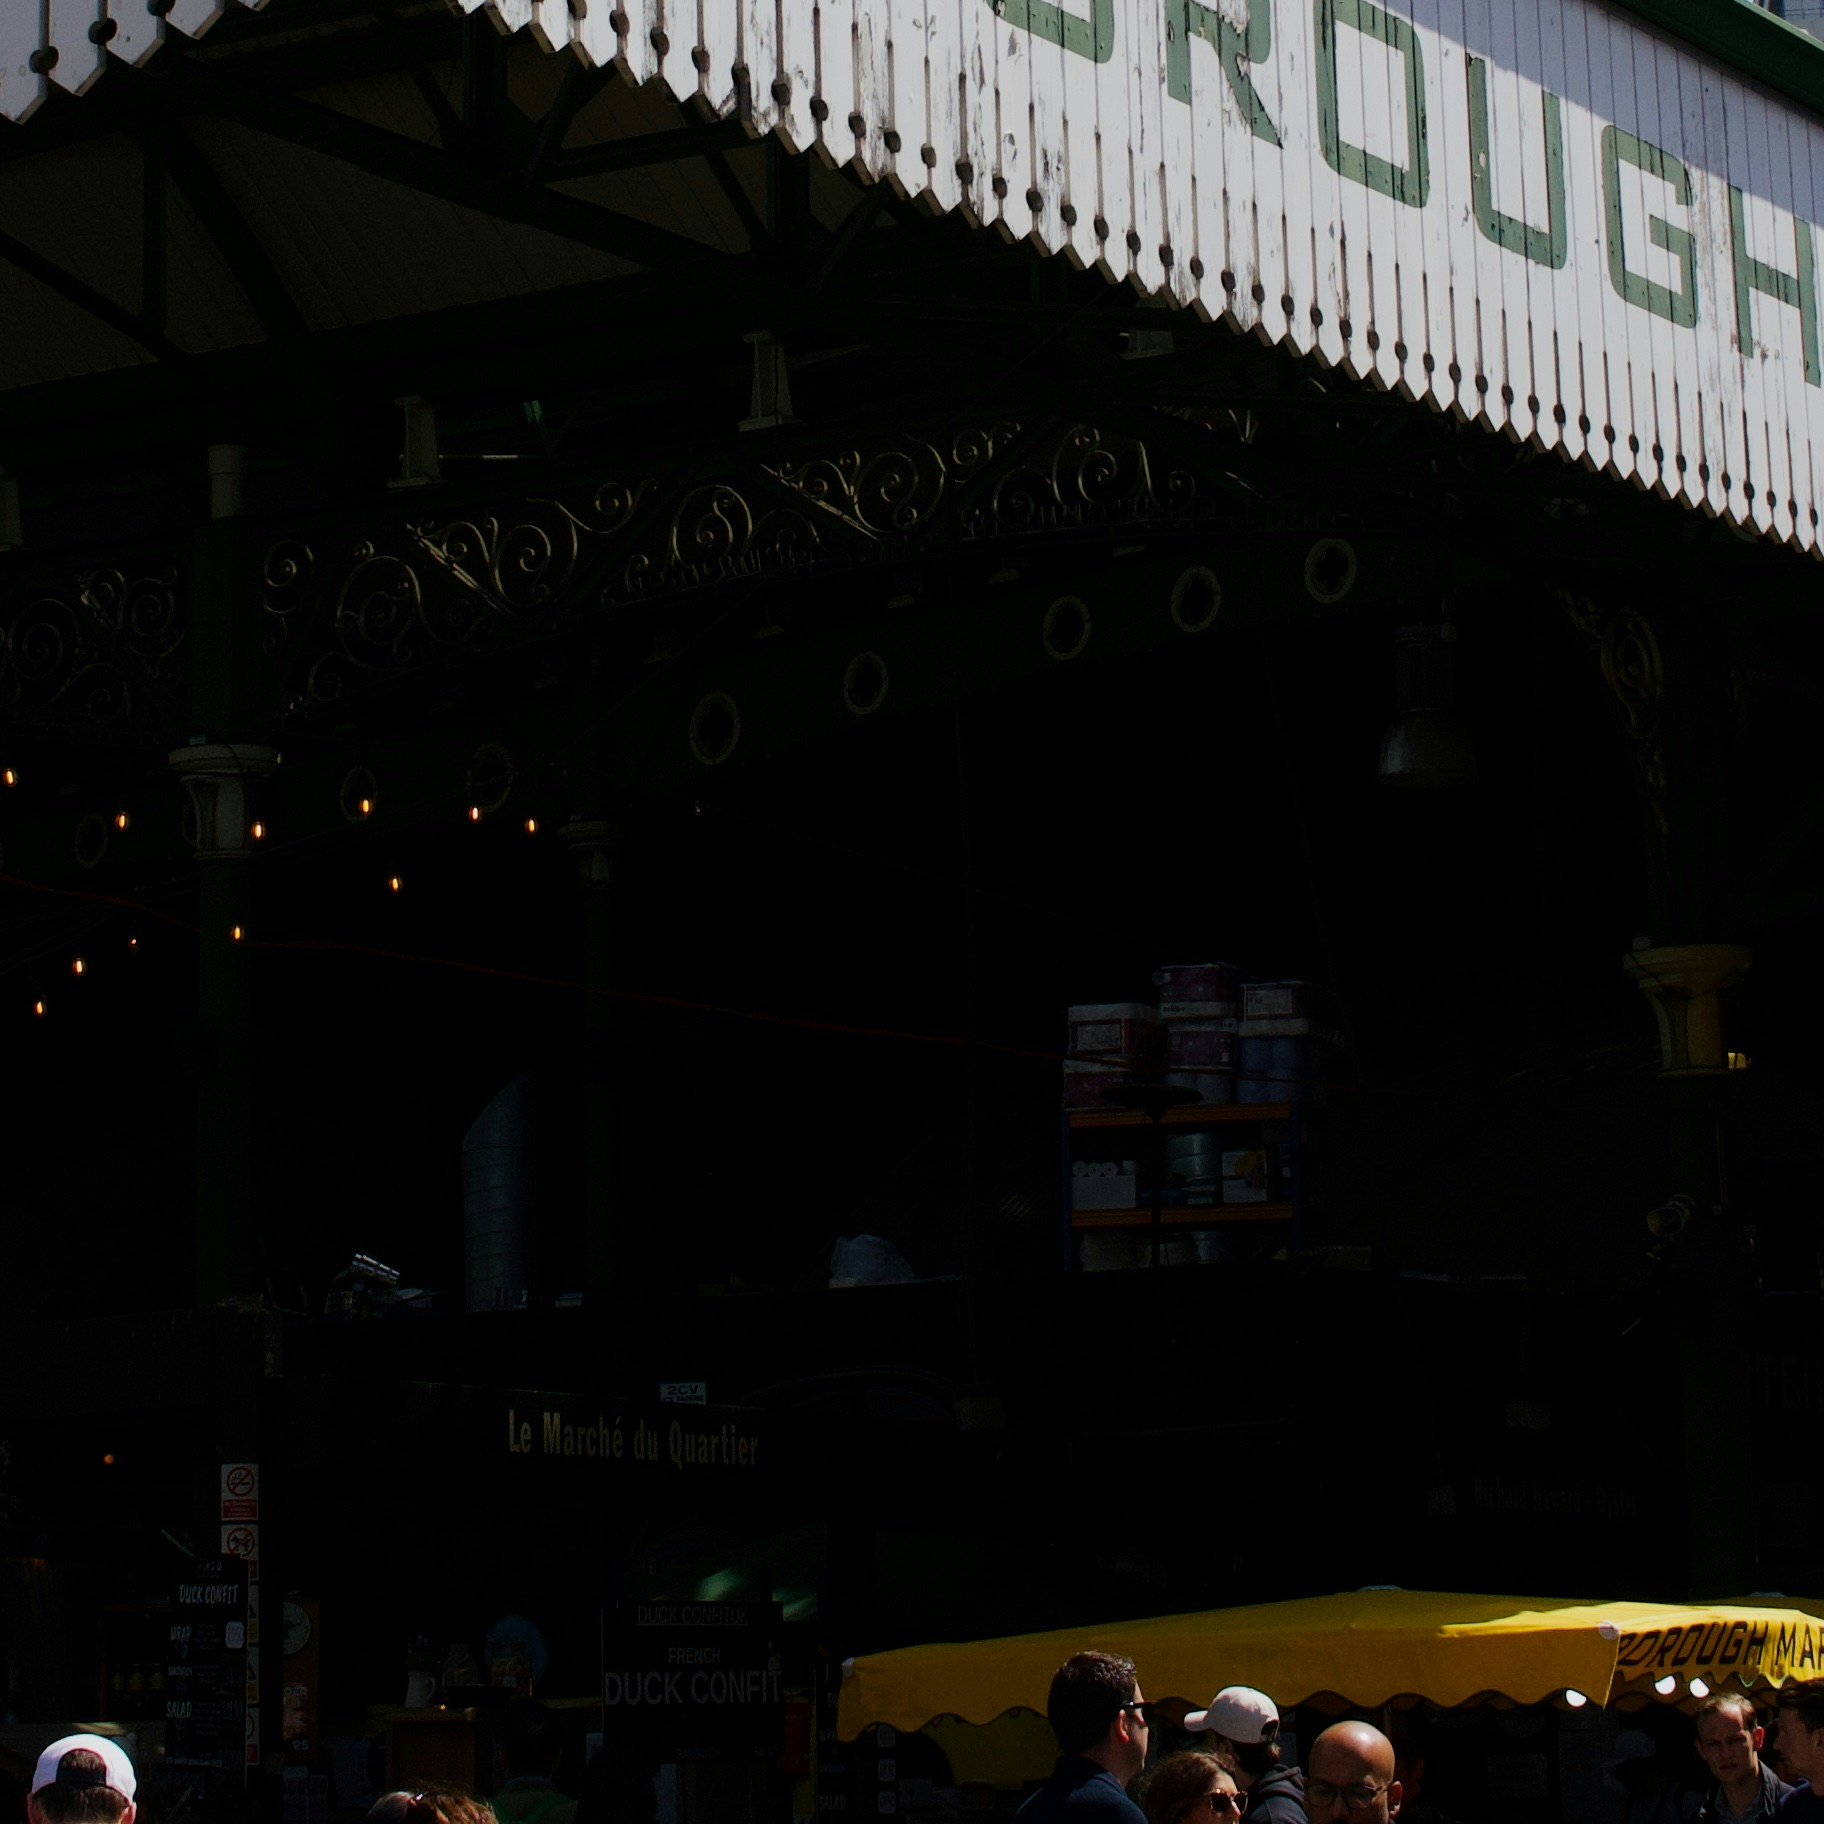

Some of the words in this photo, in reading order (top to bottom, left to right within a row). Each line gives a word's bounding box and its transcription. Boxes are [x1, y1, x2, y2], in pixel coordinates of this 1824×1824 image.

[667, 1384, 698, 1395] 2CV
[507, 1409, 532, 1455] Le
[543, 1411, 624, 1458] Marché
[633, 1418, 659, 1462] du
[668, 1420, 760, 1472] Quartier
[179, 1584, 203, 1604] DUCK
[205, 1583, 239, 1604] CONFIT
[637, 1605, 678, 1624] DUCK
[668, 1646, 721, 1664] FRENCH
[605, 1671, 683, 1706] DUCK
[690, 1669, 781, 1705] CONFIT
[166, 1700, 192, 1719] SALAD
